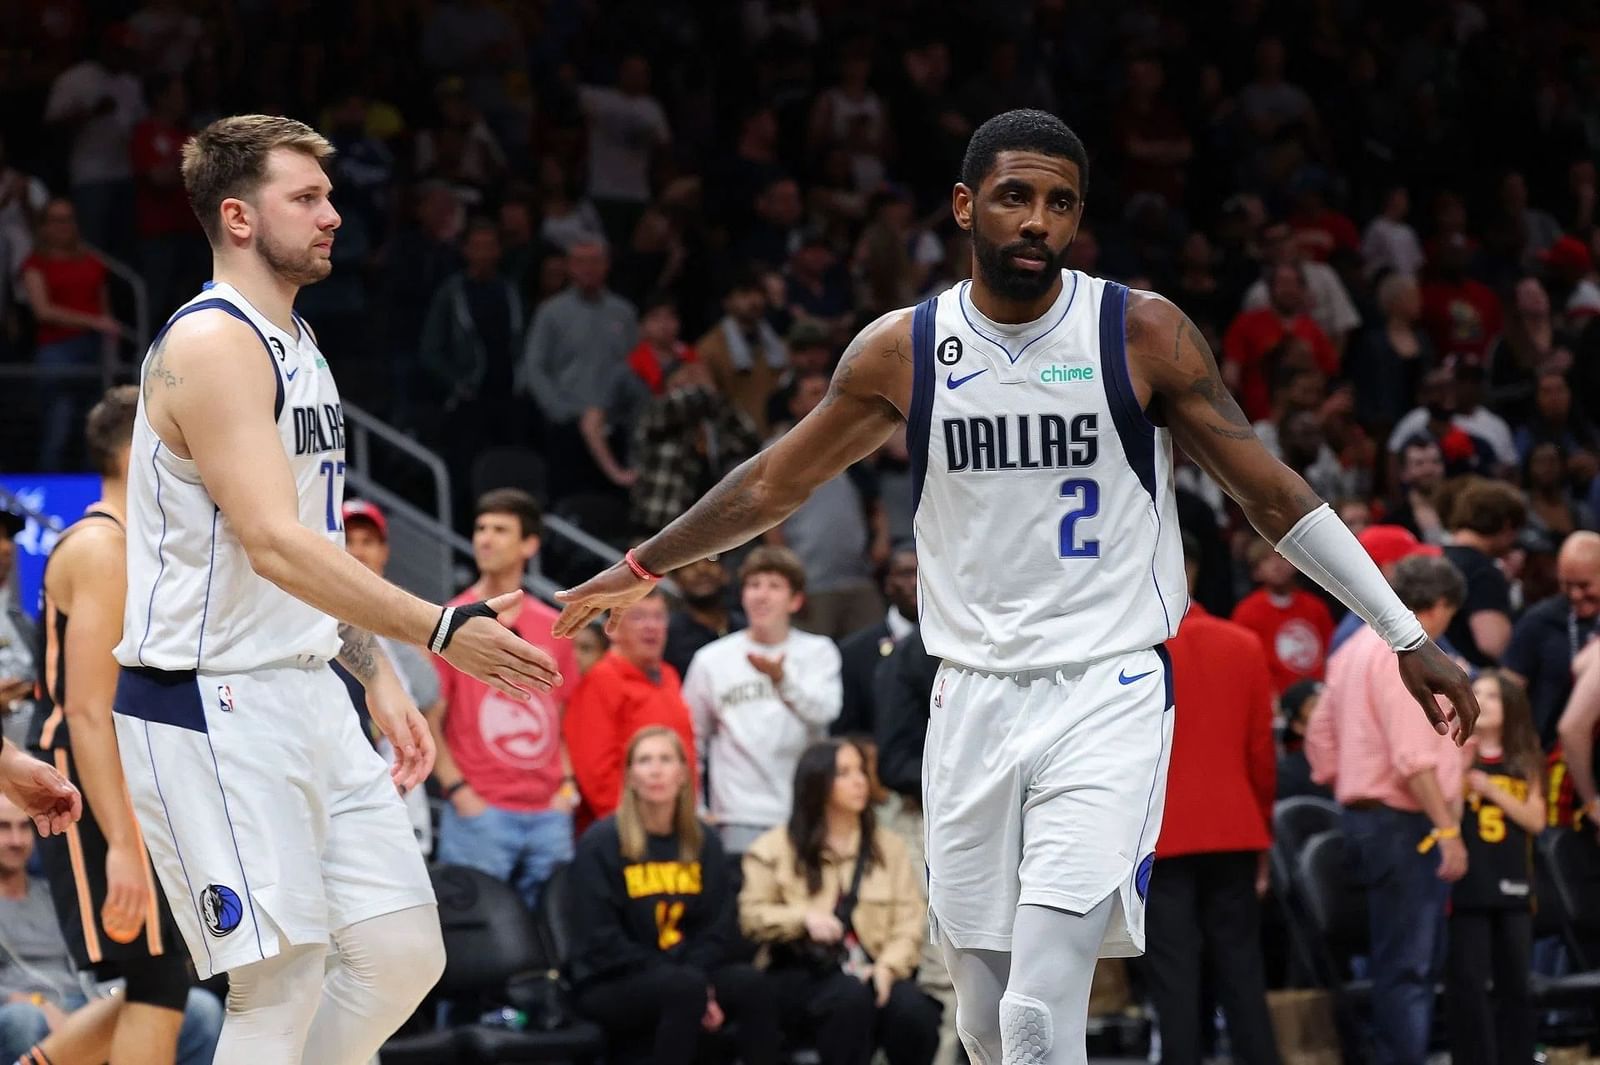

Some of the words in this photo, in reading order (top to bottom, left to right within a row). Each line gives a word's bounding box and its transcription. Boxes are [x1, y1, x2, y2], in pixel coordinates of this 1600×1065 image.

[941, 338, 960, 365] 6
[1040, 364, 1094, 382] chime
[293, 403, 345, 456] DALA
[942, 413, 1099, 473] DALLAS
[1059, 477, 1100, 559] 2
[1478, 805, 1506, 843] 5
